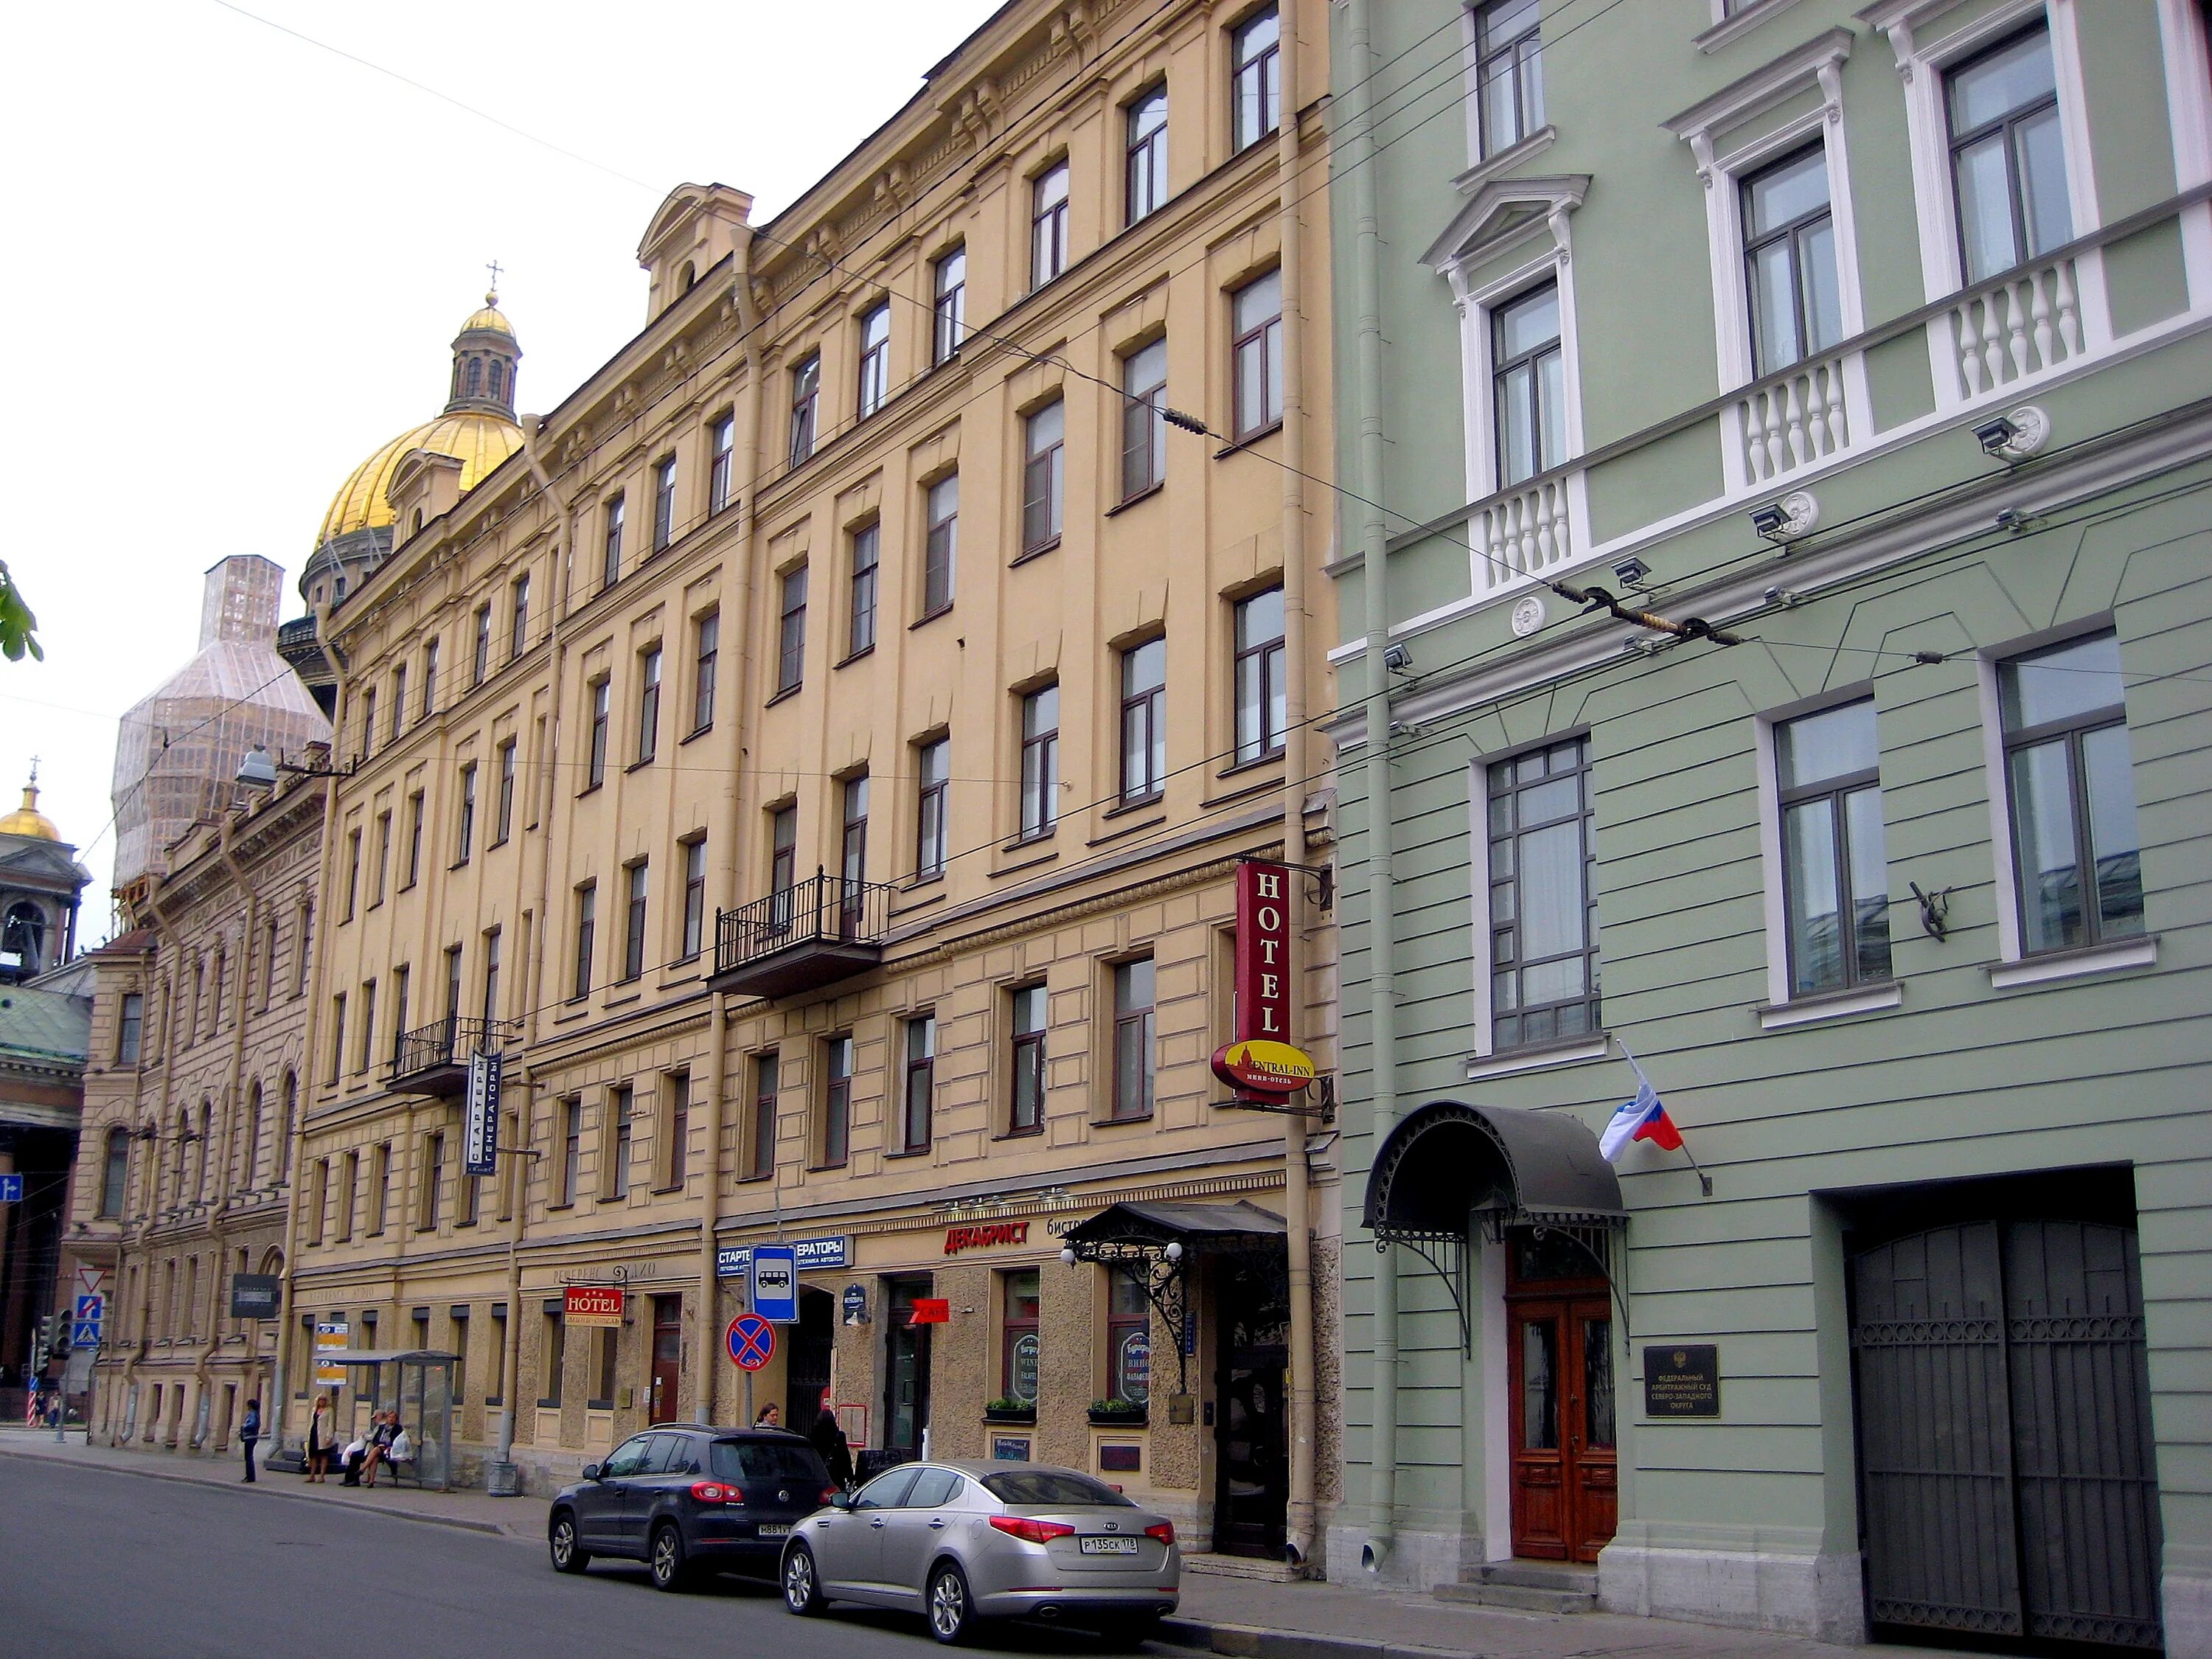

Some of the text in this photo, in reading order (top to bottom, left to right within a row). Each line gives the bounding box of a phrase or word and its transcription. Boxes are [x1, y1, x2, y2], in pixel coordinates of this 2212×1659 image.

[1256, 873, 1281, 1033] HOTEL
[1248, 1060, 1310, 1077] CENTRAL-INN
[473, 1060, 484, 1161] СТАРТЕРЫ
[485, 1062, 498, 1162] ГЕНЕРАТОРЫ
[1047, 1218, 1087, 1235] бистр
[944, 1221, 1029, 1255] ДЕКАБРИСТ
[719, 1240, 844, 1264] СТАРТЕ ЕРАТОРЫ
[567, 1297, 620, 1312] HOTEL
[1658, 1373, 1704, 1382] ФЕДЕРАЛЬНЫЙ
[1652, 1382, 1711, 1391] АРБИТРАЖНЫЙ СУД
[1652, 1392, 1712, 1400] СЕВЕРО-ЗАПАДНОГО
[1670, 1401, 1694, 1410] ОКРУГА
